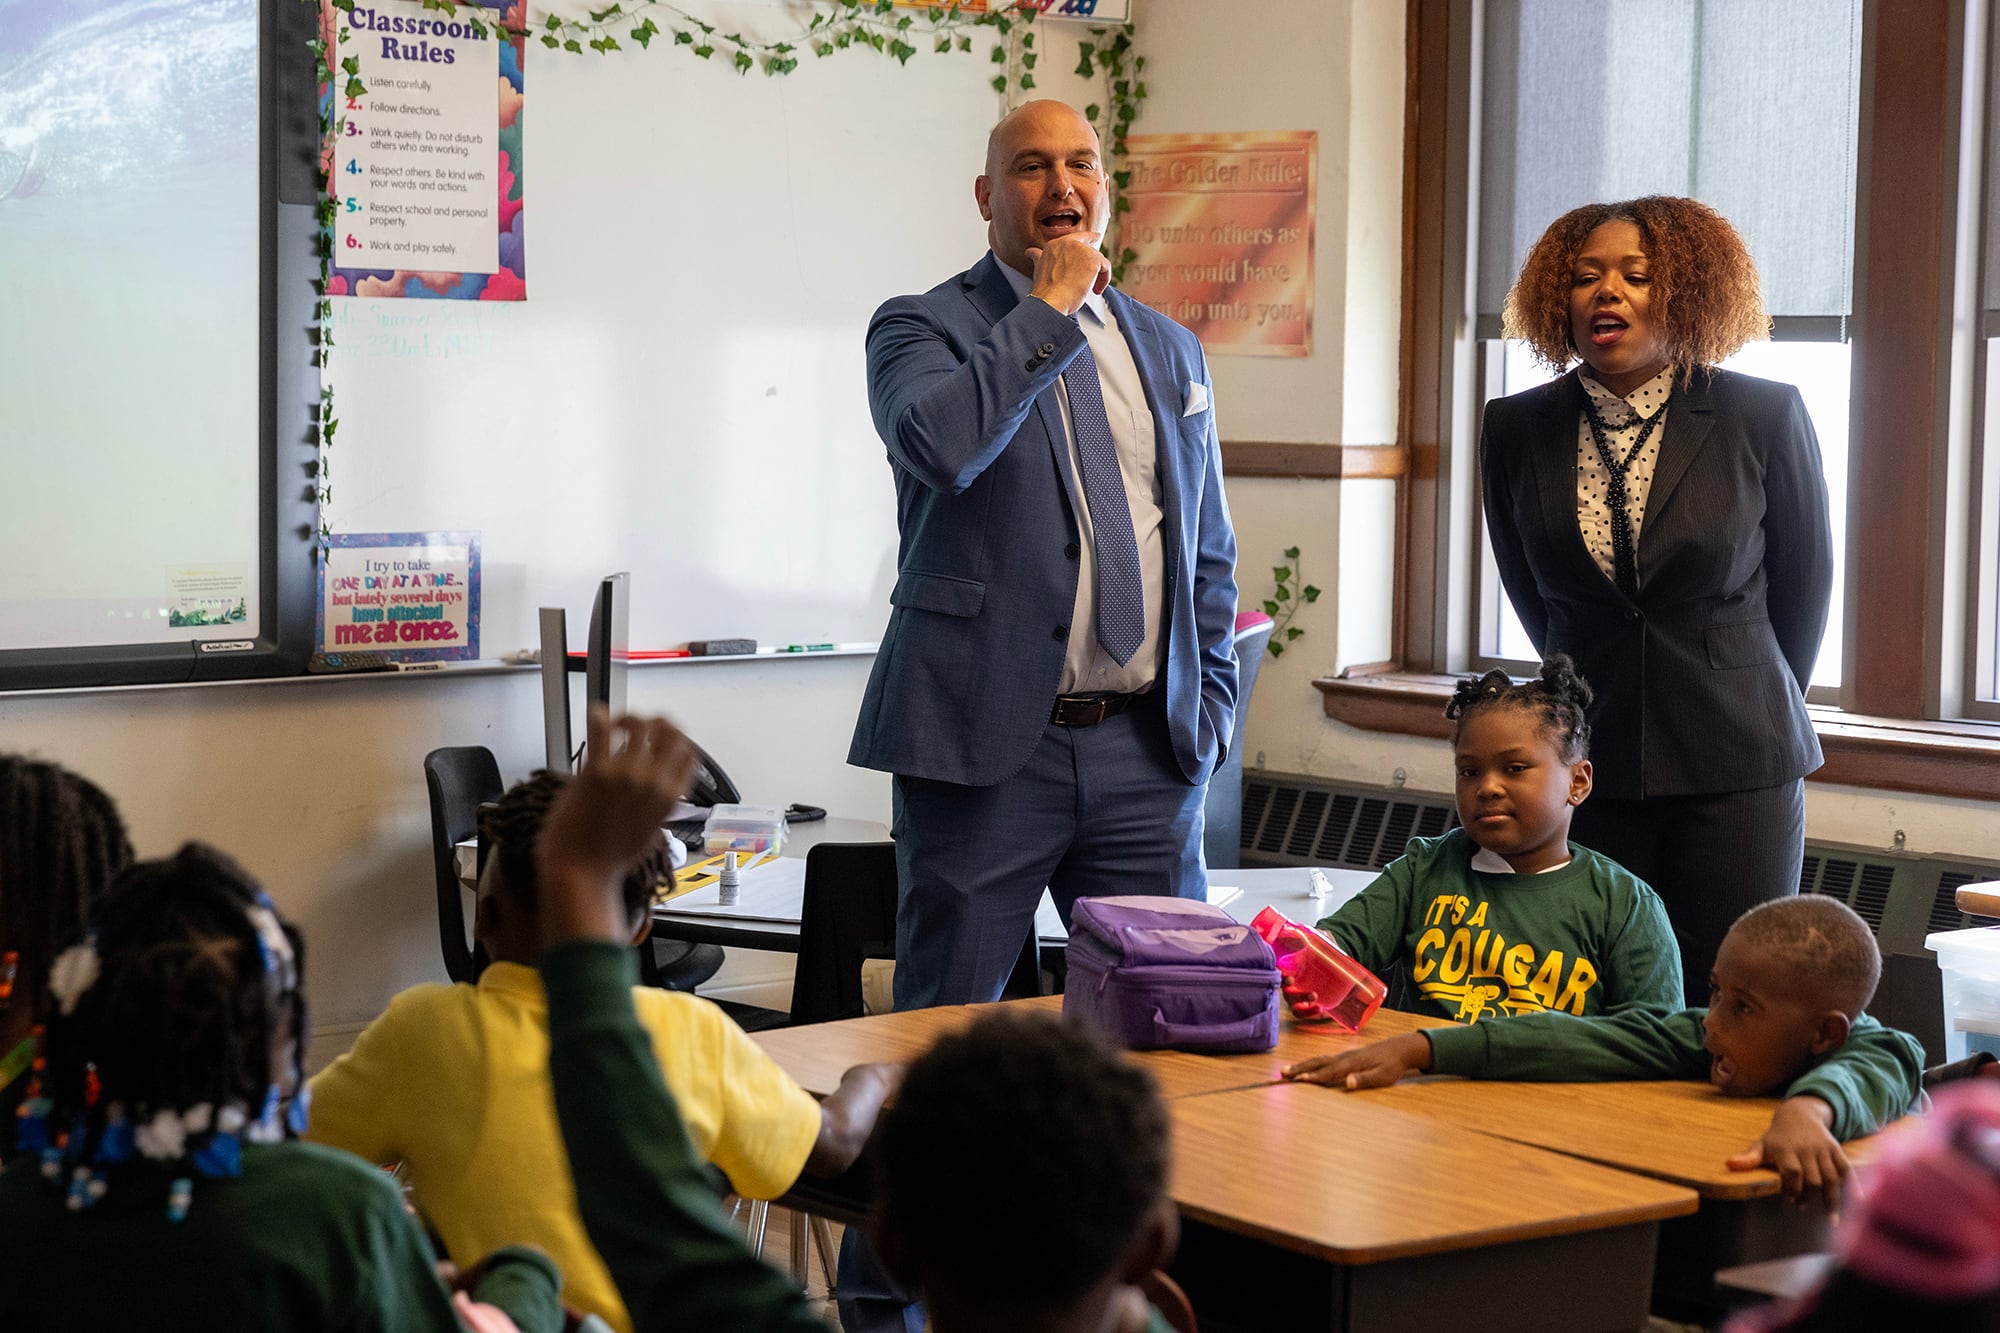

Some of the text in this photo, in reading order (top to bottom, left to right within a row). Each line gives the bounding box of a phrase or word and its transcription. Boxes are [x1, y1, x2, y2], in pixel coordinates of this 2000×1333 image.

[381, 37, 455, 64] Rules
[370, 77, 394, 88] Listen
[346, 97, 363, 110] 2.
[370, 102, 397, 113] Follow
[346, 121, 363, 137] 3.
[370, 127, 392, 138] Work
[425, 130, 437, 141] Do
[439, 132, 453, 142] not
[454, 131, 483, 144] disturb
[370, 140, 397, 151] others
[399, 141, 417, 152] who
[419, 144, 433, 154] are
[345, 158, 363, 175] 4.
[370, 164, 403, 177] Respect
[435, 168, 446, 179] Be
[448, 169, 465, 180] kind
[467, 171, 485, 181] with
[1125, 157, 1303, 185] The Golden Rule:
[370, 179, 388, 189] your
[390, 180, 416, 190] words
[418, 181, 435, 191] and
[345, 197, 488, 219] 5. Respect school and personal
[345, 233, 363, 249] 6.
[370, 239, 392, 250] Work
[393, 240, 410, 251] and
[412, 241, 430, 255] play
[1160, 223, 1205, 244] unto
[1210, 221, 1273, 245] others
[1278, 227, 1301, 245] as
[1133, 257, 1291, 286] you would have
[1178, 296, 1203, 321] do
[1207, 300, 1250, 322] unto
[365, 559, 431, 575] I try to take
[332, 576, 360, 590] ONE
[364, 576, 389, 590] DAY
[392, 574, 409, 588] AT
[411, 574, 421, 587] A
[332, 589, 462, 607] but lately several days
[352, 604, 443, 623] have attacked
[335, 620, 459, 645] me at once.
[1424, 894, 1489, 928] IT'S A
[1413, 927, 1598, 1017] COUGAR
